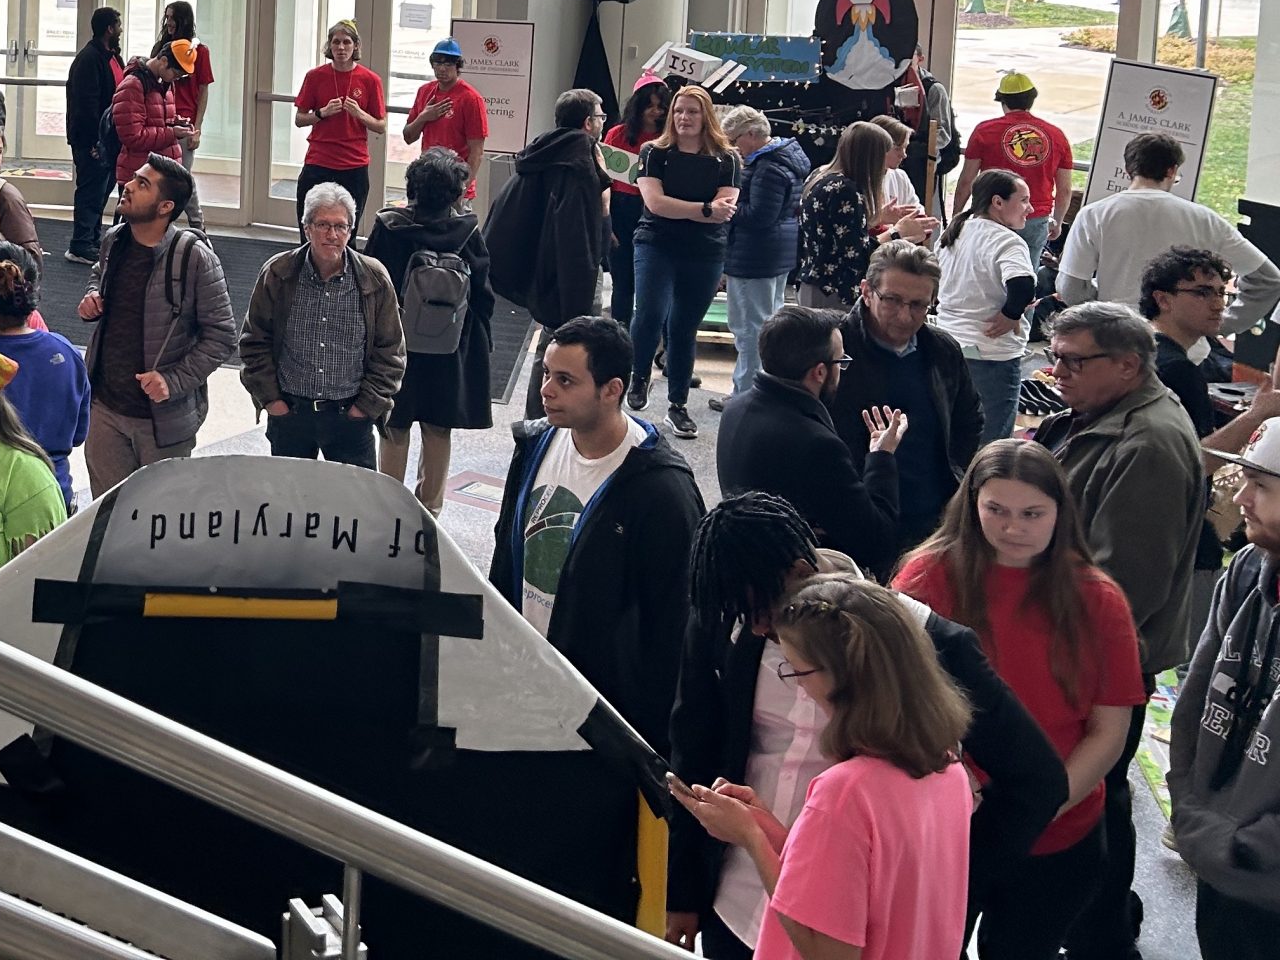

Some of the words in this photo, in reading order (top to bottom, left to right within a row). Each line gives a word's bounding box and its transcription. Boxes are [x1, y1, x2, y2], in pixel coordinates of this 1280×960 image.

[494, 59, 519, 68] CLARK
[668, 54, 696, 75] ISS
[1129, 112, 1158, 126] JAMES
[1160, 119, 1192, 132] CLARK
[131, 502, 358, 553] Maryland,
